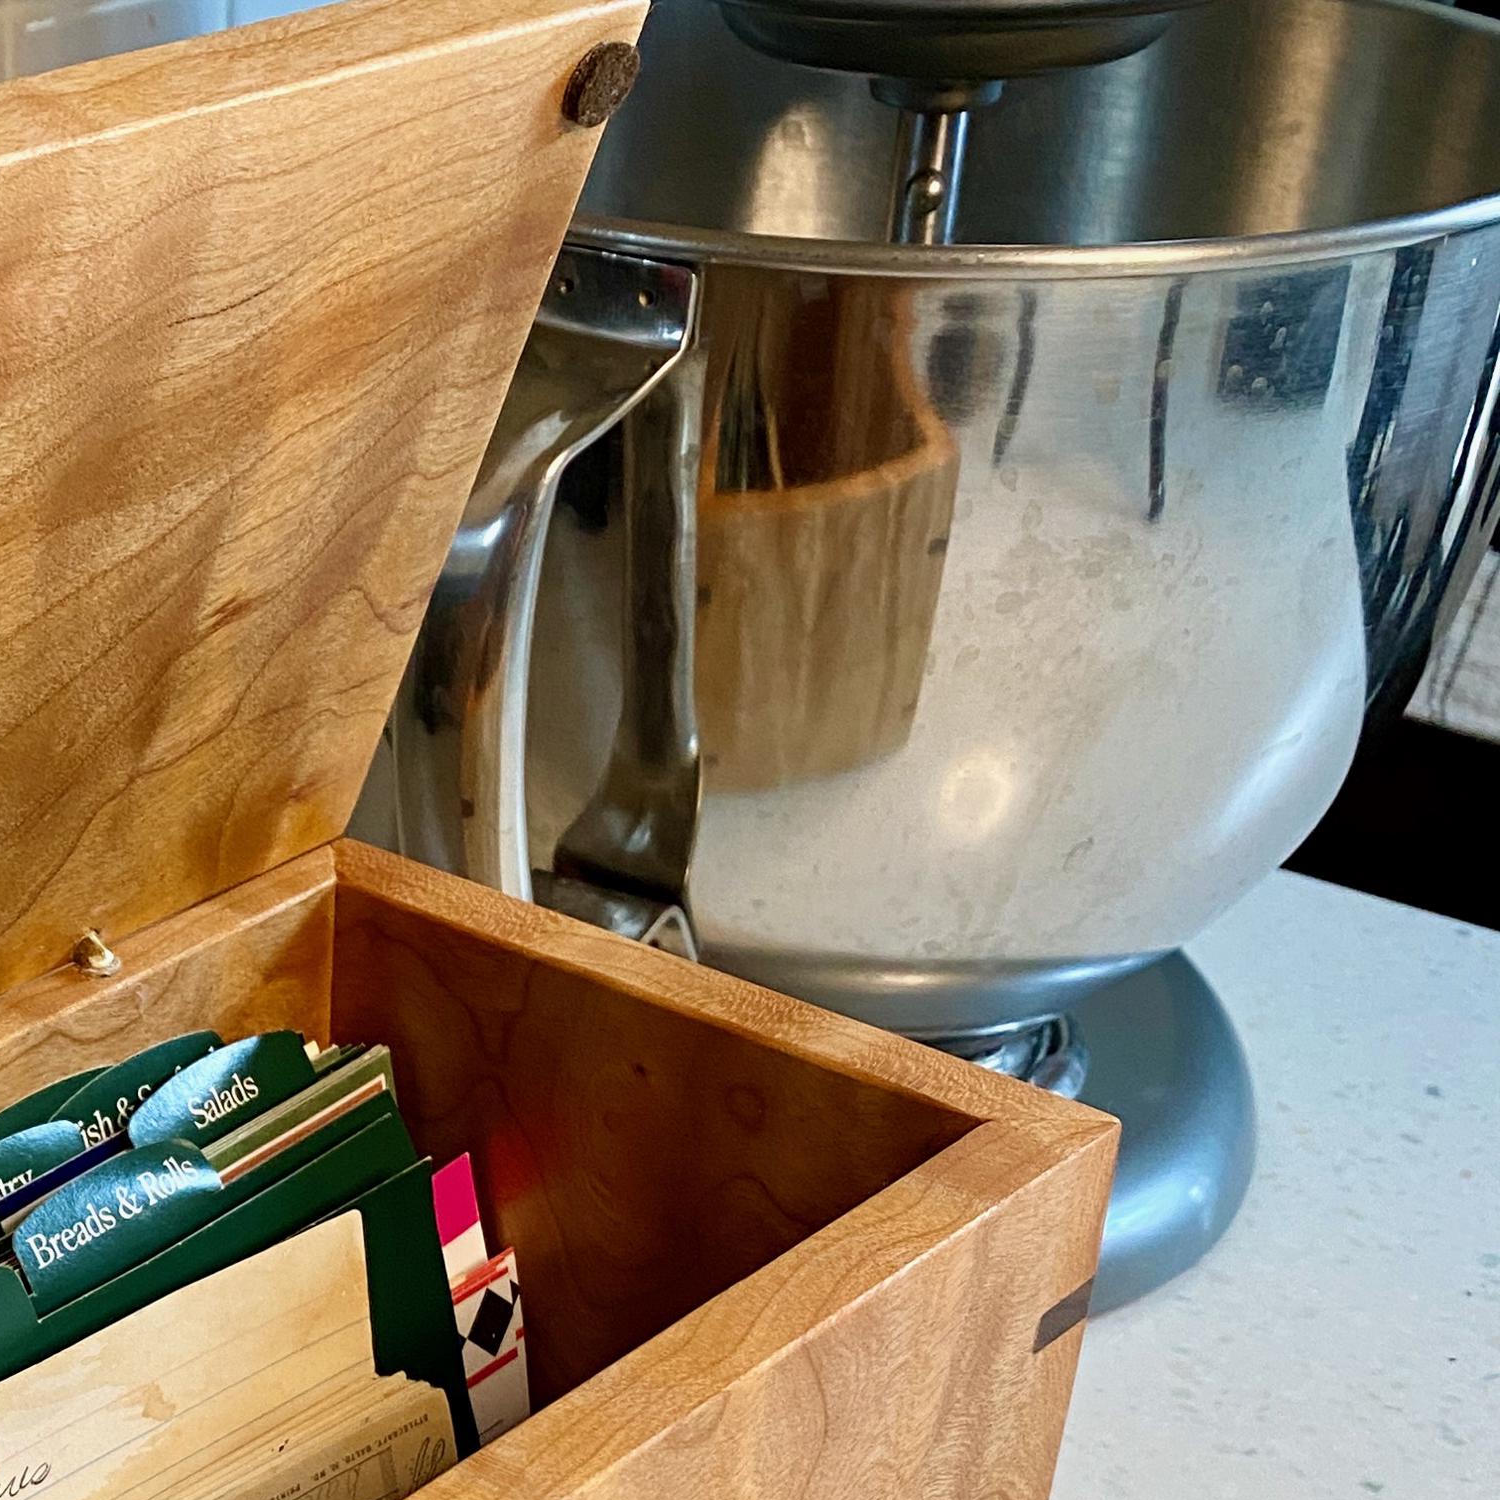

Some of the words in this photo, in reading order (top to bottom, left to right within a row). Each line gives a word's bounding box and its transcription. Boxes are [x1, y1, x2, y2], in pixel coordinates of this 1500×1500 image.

[188, 1070, 260, 1130] Salads
[77, 1110, 115, 1151] ish
[25, 1200, 117, 1269] Breads
[116, 1182, 145, 1219] &
[137, 1156, 200, 1207] Rolls
